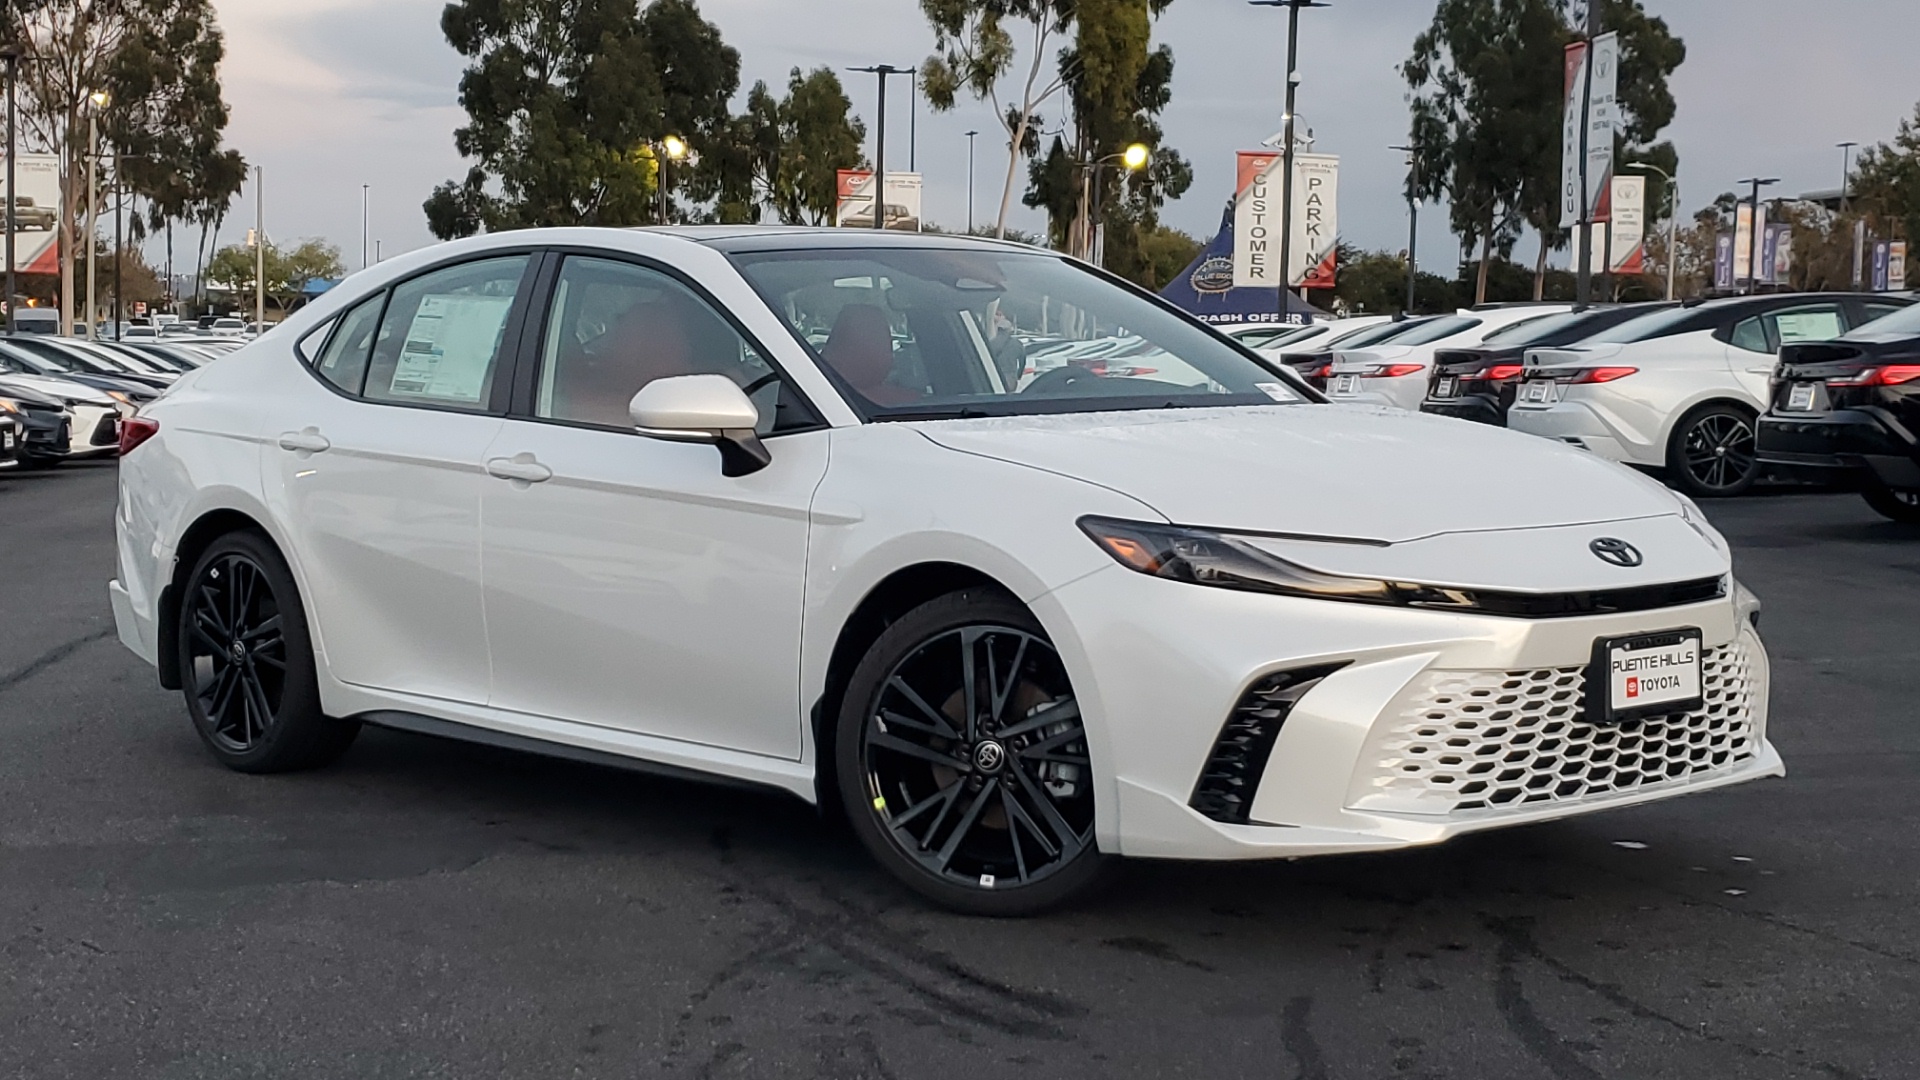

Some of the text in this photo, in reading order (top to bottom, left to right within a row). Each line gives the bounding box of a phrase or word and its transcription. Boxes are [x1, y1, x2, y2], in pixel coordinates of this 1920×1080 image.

[1249, 174, 1267, 279] CUSTOMER
[1304, 178, 1323, 280] PARKING
[1198, 314, 1243, 322] CASH
[1612, 651, 1694, 673] PUENTE HILLS
[1640, 675, 1681, 692] TOYOTA
